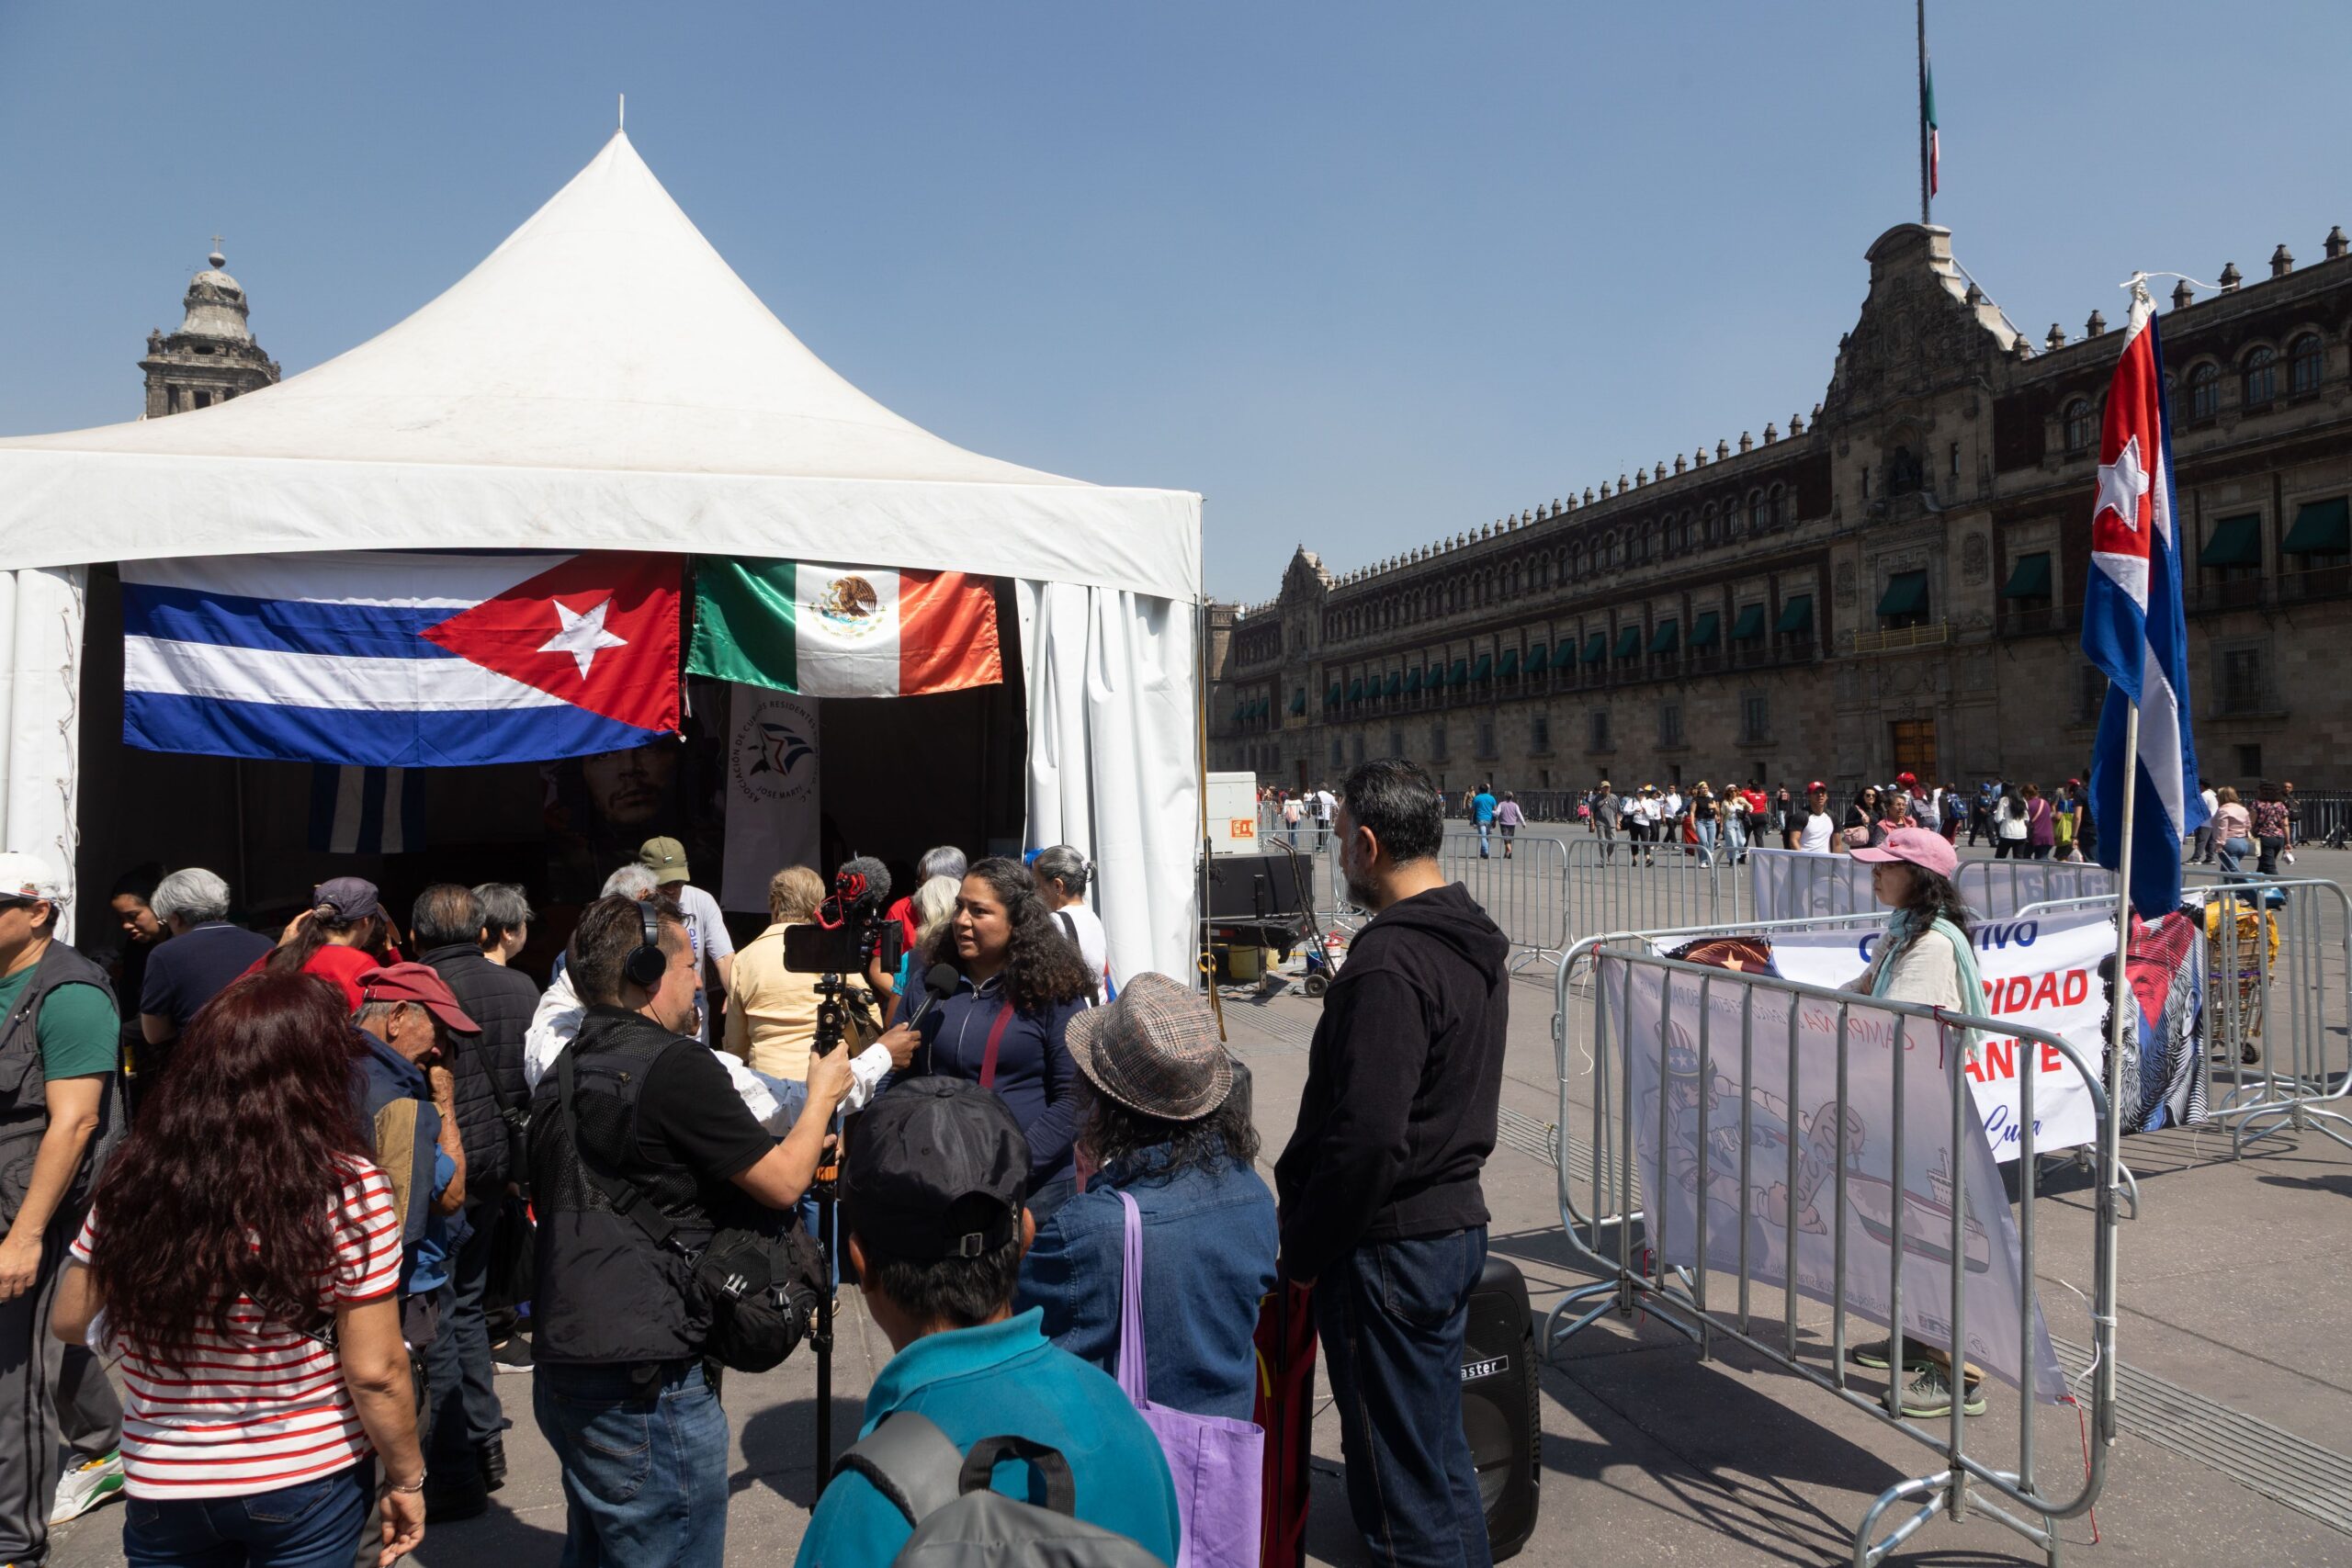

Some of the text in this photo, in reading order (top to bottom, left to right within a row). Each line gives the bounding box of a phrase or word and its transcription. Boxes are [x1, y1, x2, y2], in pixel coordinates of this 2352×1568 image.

[735, 733, 746, 746] DE
[770, 701, 816, 728] RESIDENTES
[1984, 1105, 2042, 1151] Cua
[1461, 1361, 1497, 1379] aster
